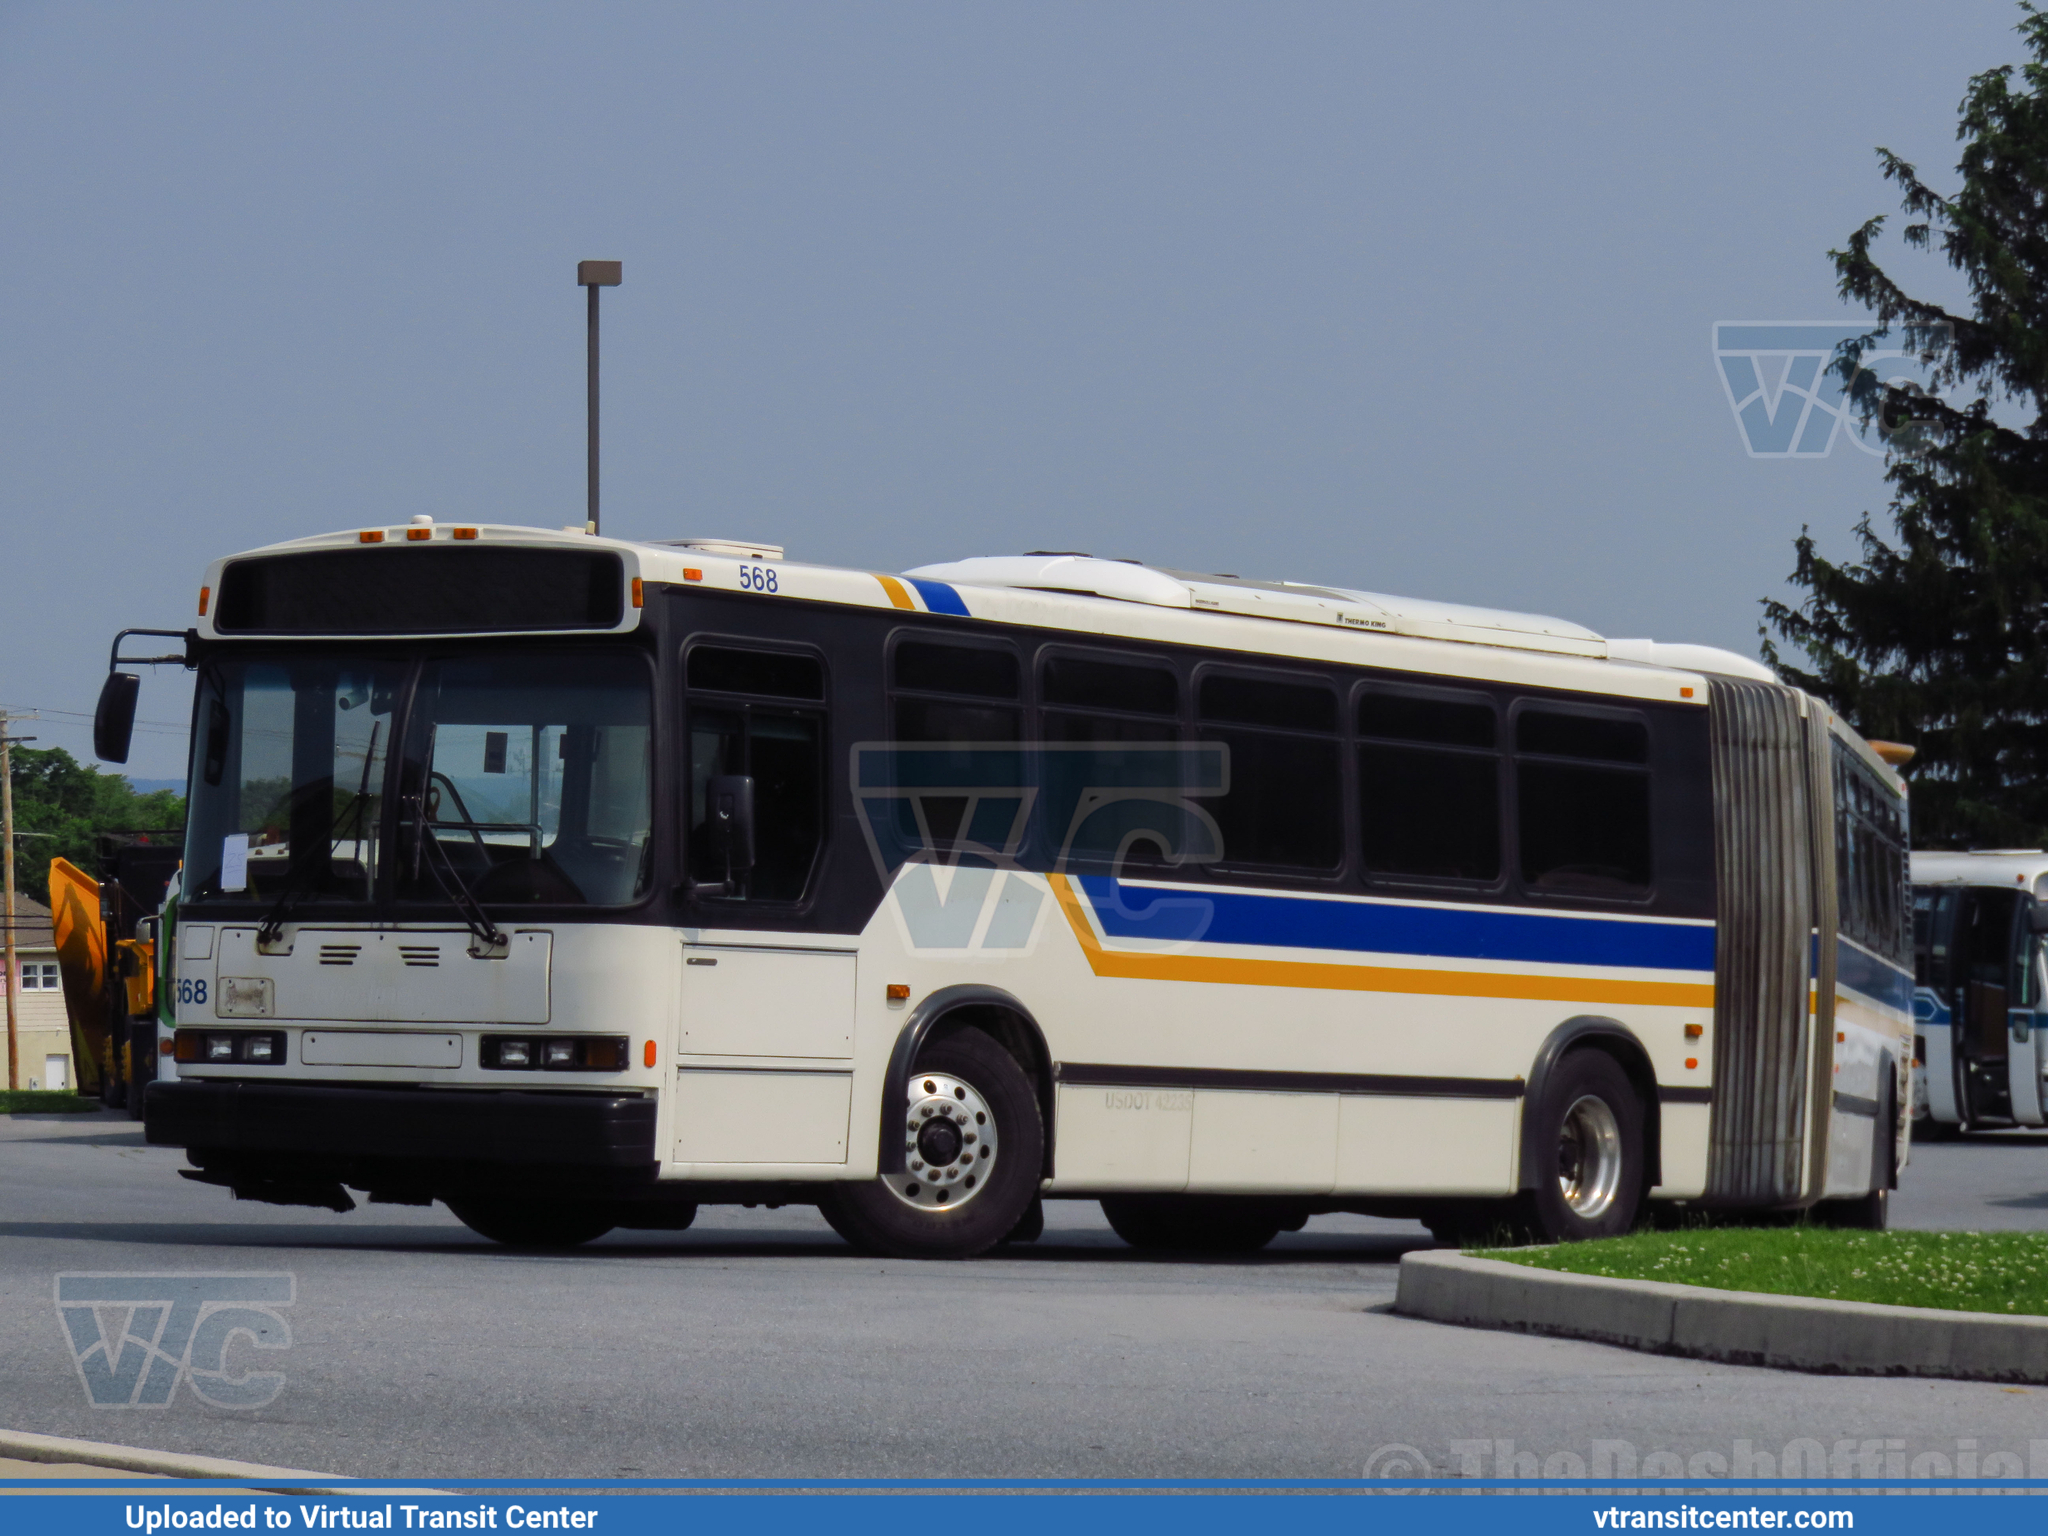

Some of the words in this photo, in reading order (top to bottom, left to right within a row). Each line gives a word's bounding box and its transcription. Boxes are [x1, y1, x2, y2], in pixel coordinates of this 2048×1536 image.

[739, 564, 778, 594] 568
[1344, 617, 1369, 627] THERMO
[1370, 620, 1386, 629] KING
